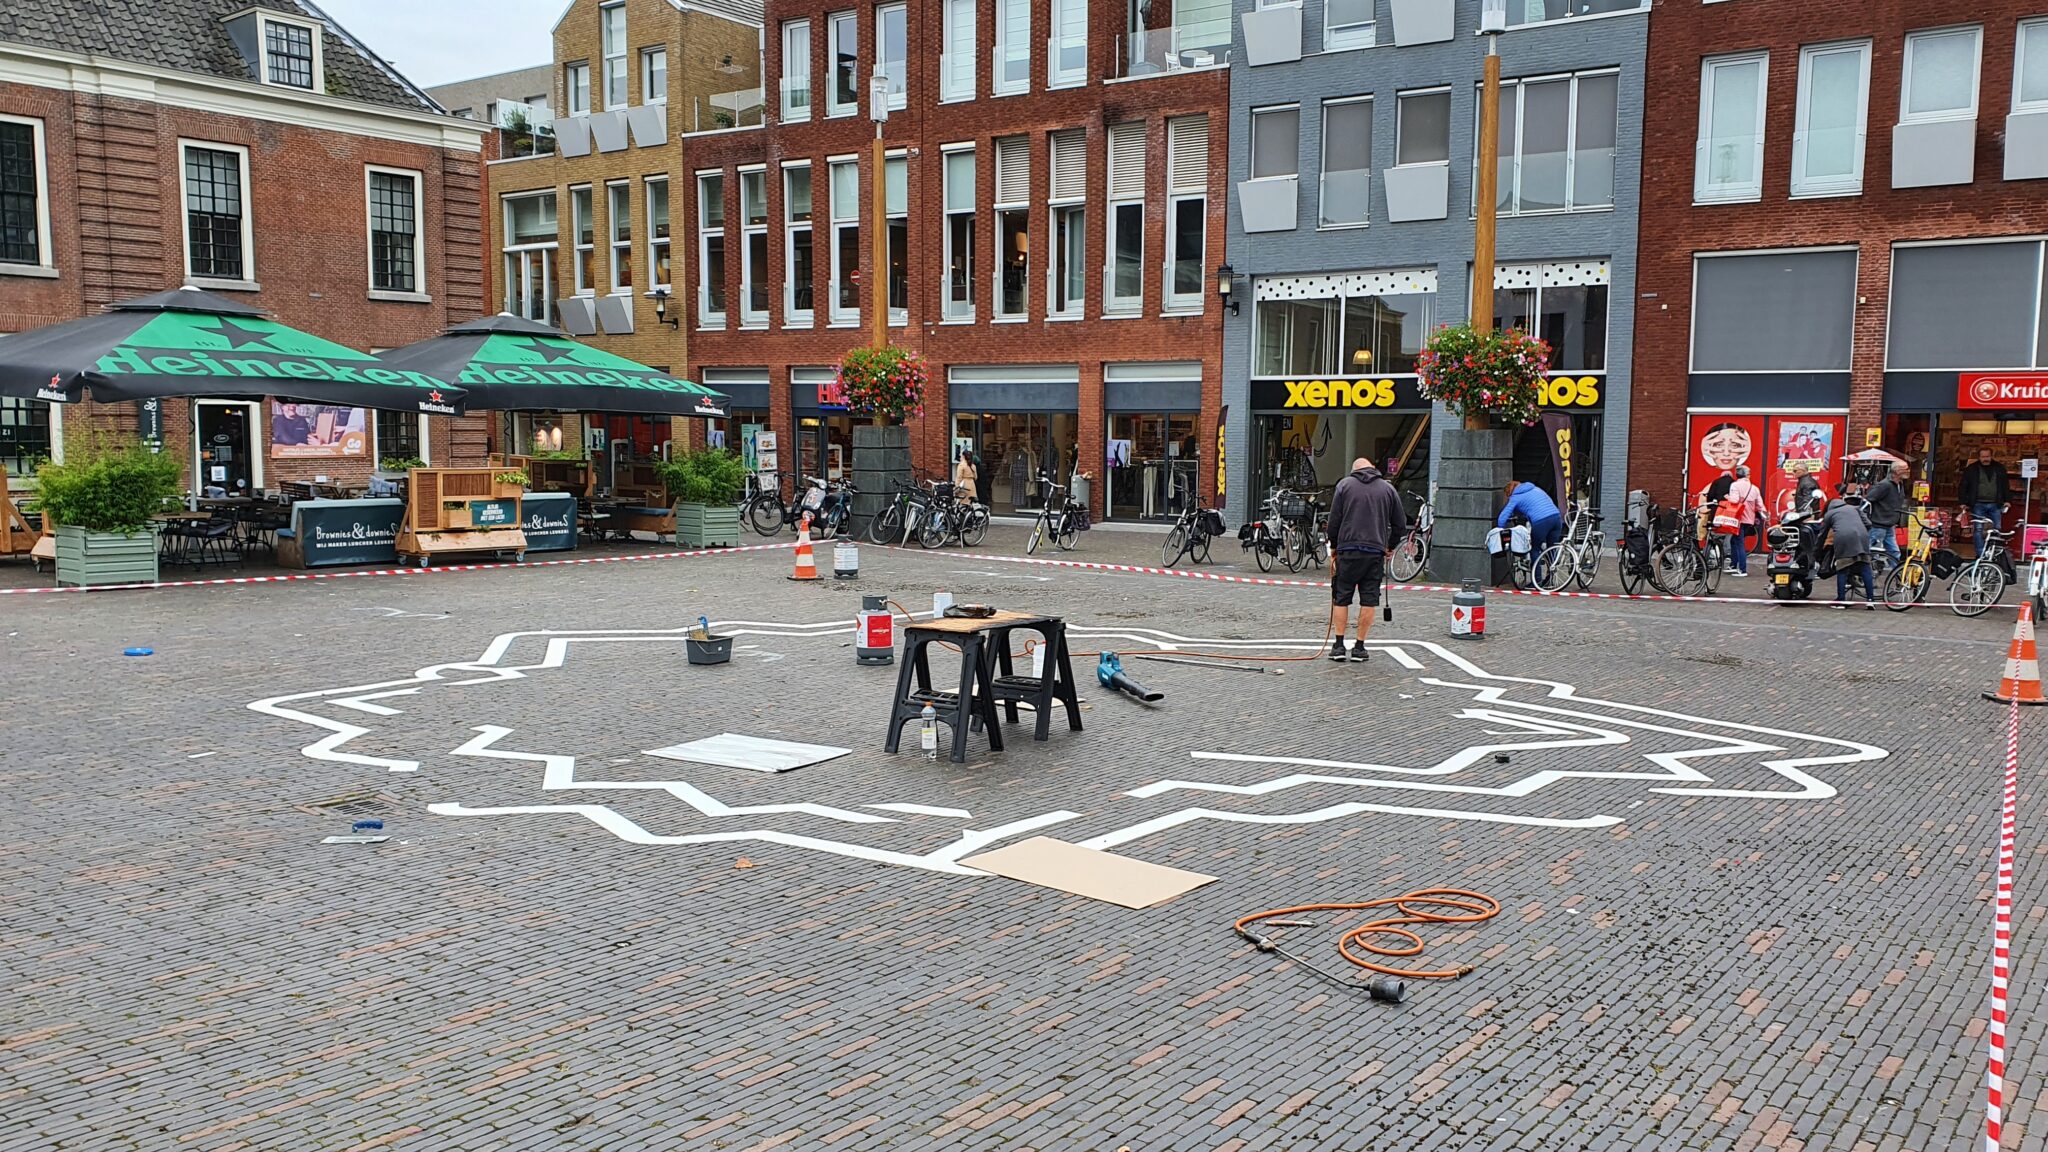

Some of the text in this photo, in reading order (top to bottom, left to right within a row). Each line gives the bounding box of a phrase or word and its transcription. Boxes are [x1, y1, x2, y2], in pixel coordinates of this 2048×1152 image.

[98, 345, 468, 391] Heineken
[457, 364, 733, 398] Heineken
[418, 401, 455, 414] Heineken
[1283, 379, 1396, 408] xenos
[1217, 424, 1226, 497] xenos
[316, 526, 351, 540] Brownies
[352, 522, 366, 539] &
[532, 514, 543, 529] &
